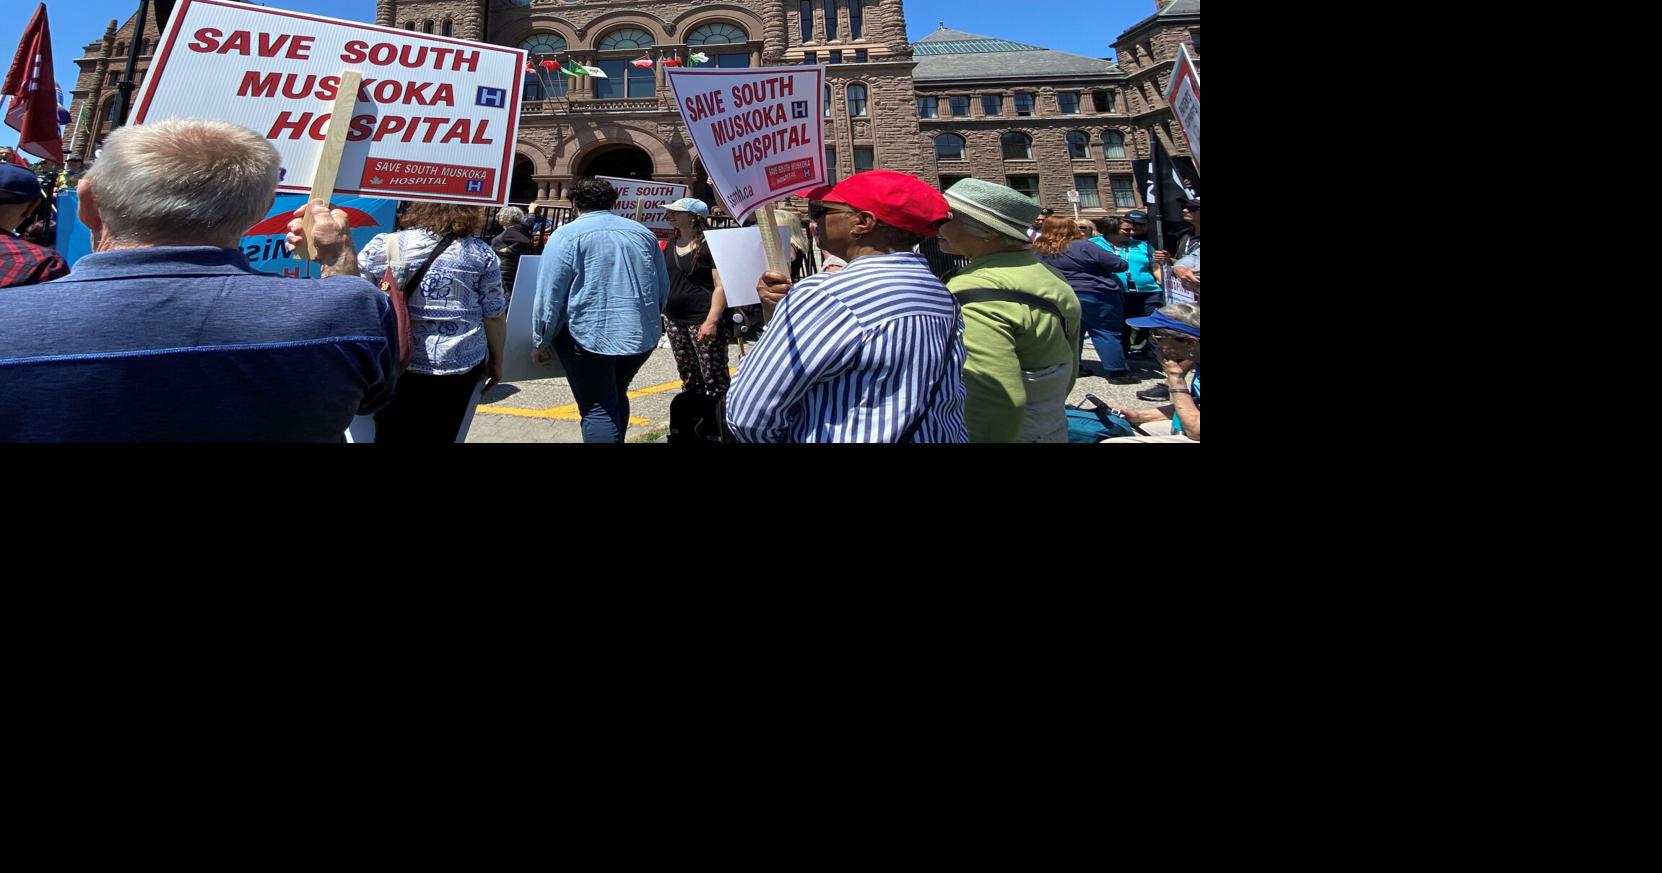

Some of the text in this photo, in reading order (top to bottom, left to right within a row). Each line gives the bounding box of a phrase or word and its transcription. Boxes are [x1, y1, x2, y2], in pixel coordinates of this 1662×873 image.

[188, 27, 480, 72] SAVE SOUTH
[685, 75, 794, 122] SAVE SOUTH
[710, 103, 787, 147] MUSKOKA
[731, 123, 811, 173] HOSPITAL
[375, 161, 487, 180] SAVE SOUTH MUSKOKA
[389, 177, 448, 185] HOSPITAL
[636, 187, 674, 196] SOUTH
